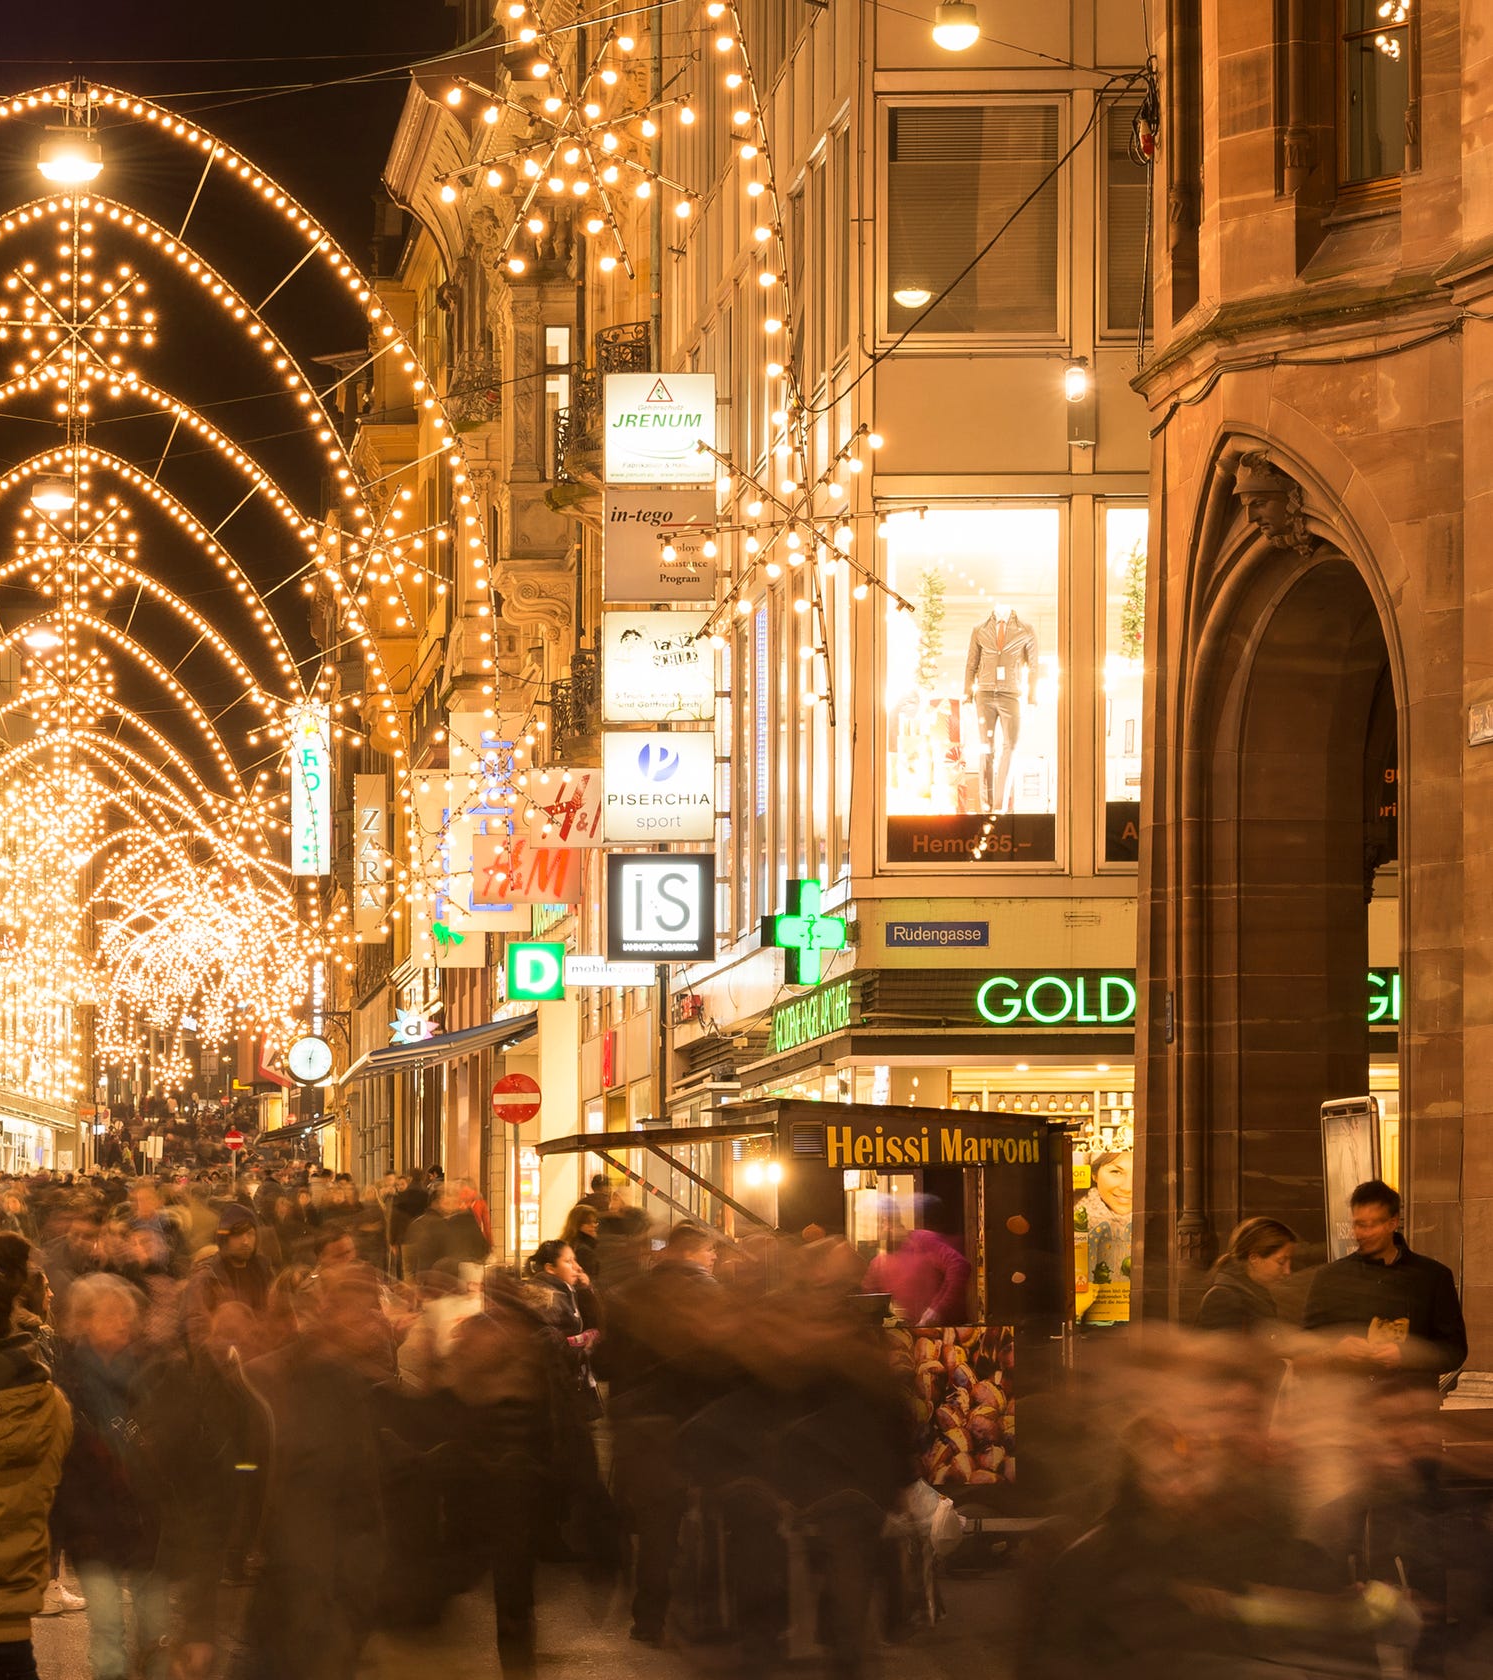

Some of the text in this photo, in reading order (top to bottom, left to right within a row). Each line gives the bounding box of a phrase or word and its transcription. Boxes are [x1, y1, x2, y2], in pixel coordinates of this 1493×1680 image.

[613, 414, 702, 428] JRENUM
[611, 507, 673, 527] in-tego
[659, 574, 700, 585] Program
[607, 794, 710, 806] PISERCHIA
[636, 816, 681, 830] sport
[913, 834, 980, 853] Hemd
[893, 926, 982, 944] Rüdengasse
[976, 976, 1136, 1023] GOLD
[827, 1126, 1040, 1167] Heissi Marroni
